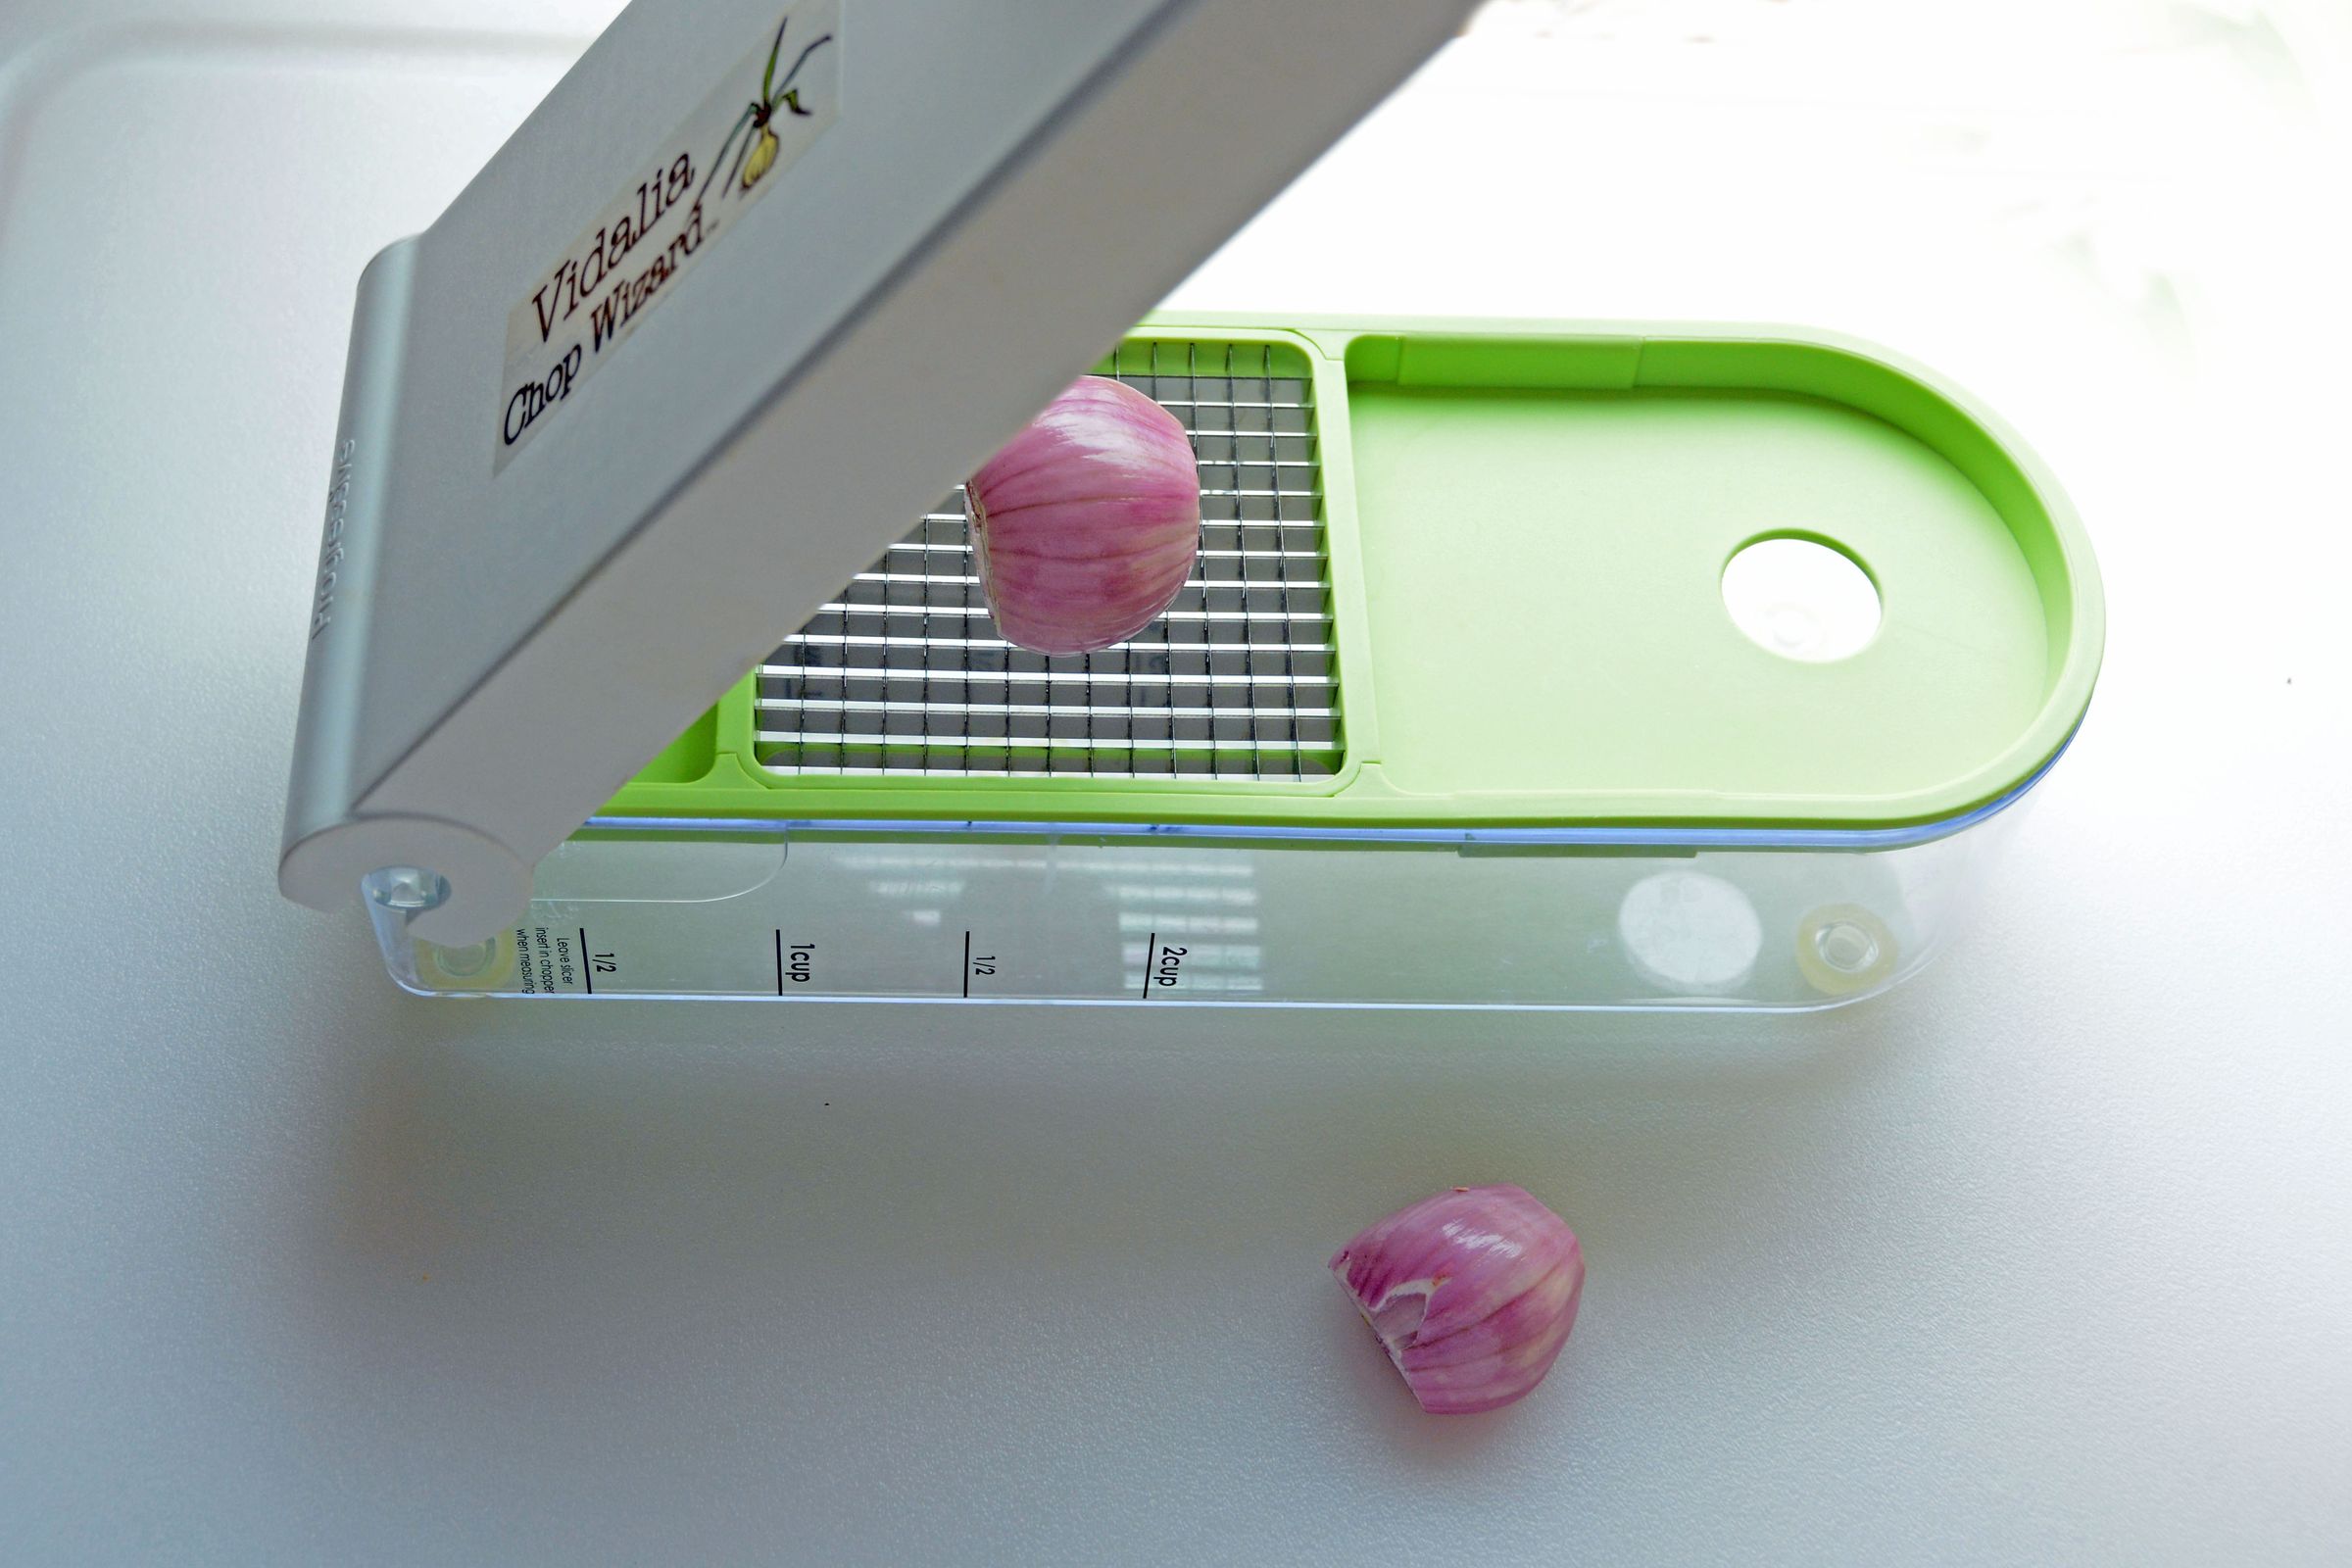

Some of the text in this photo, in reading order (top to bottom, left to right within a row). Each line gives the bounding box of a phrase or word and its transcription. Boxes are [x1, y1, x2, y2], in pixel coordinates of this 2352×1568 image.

[531, 152, 696, 343] Vidalia
[503, 201, 703, 446] Chop Wizard
[535, 927, 550, 949] insert
[516, 929, 537, 994] when measuring
[539, 959, 556, 994] chopper
[557, 938, 574, 985] Leave slicer
[592, 953, 617, 973] 1/2
[972, 955, 997, 976] 1/2
